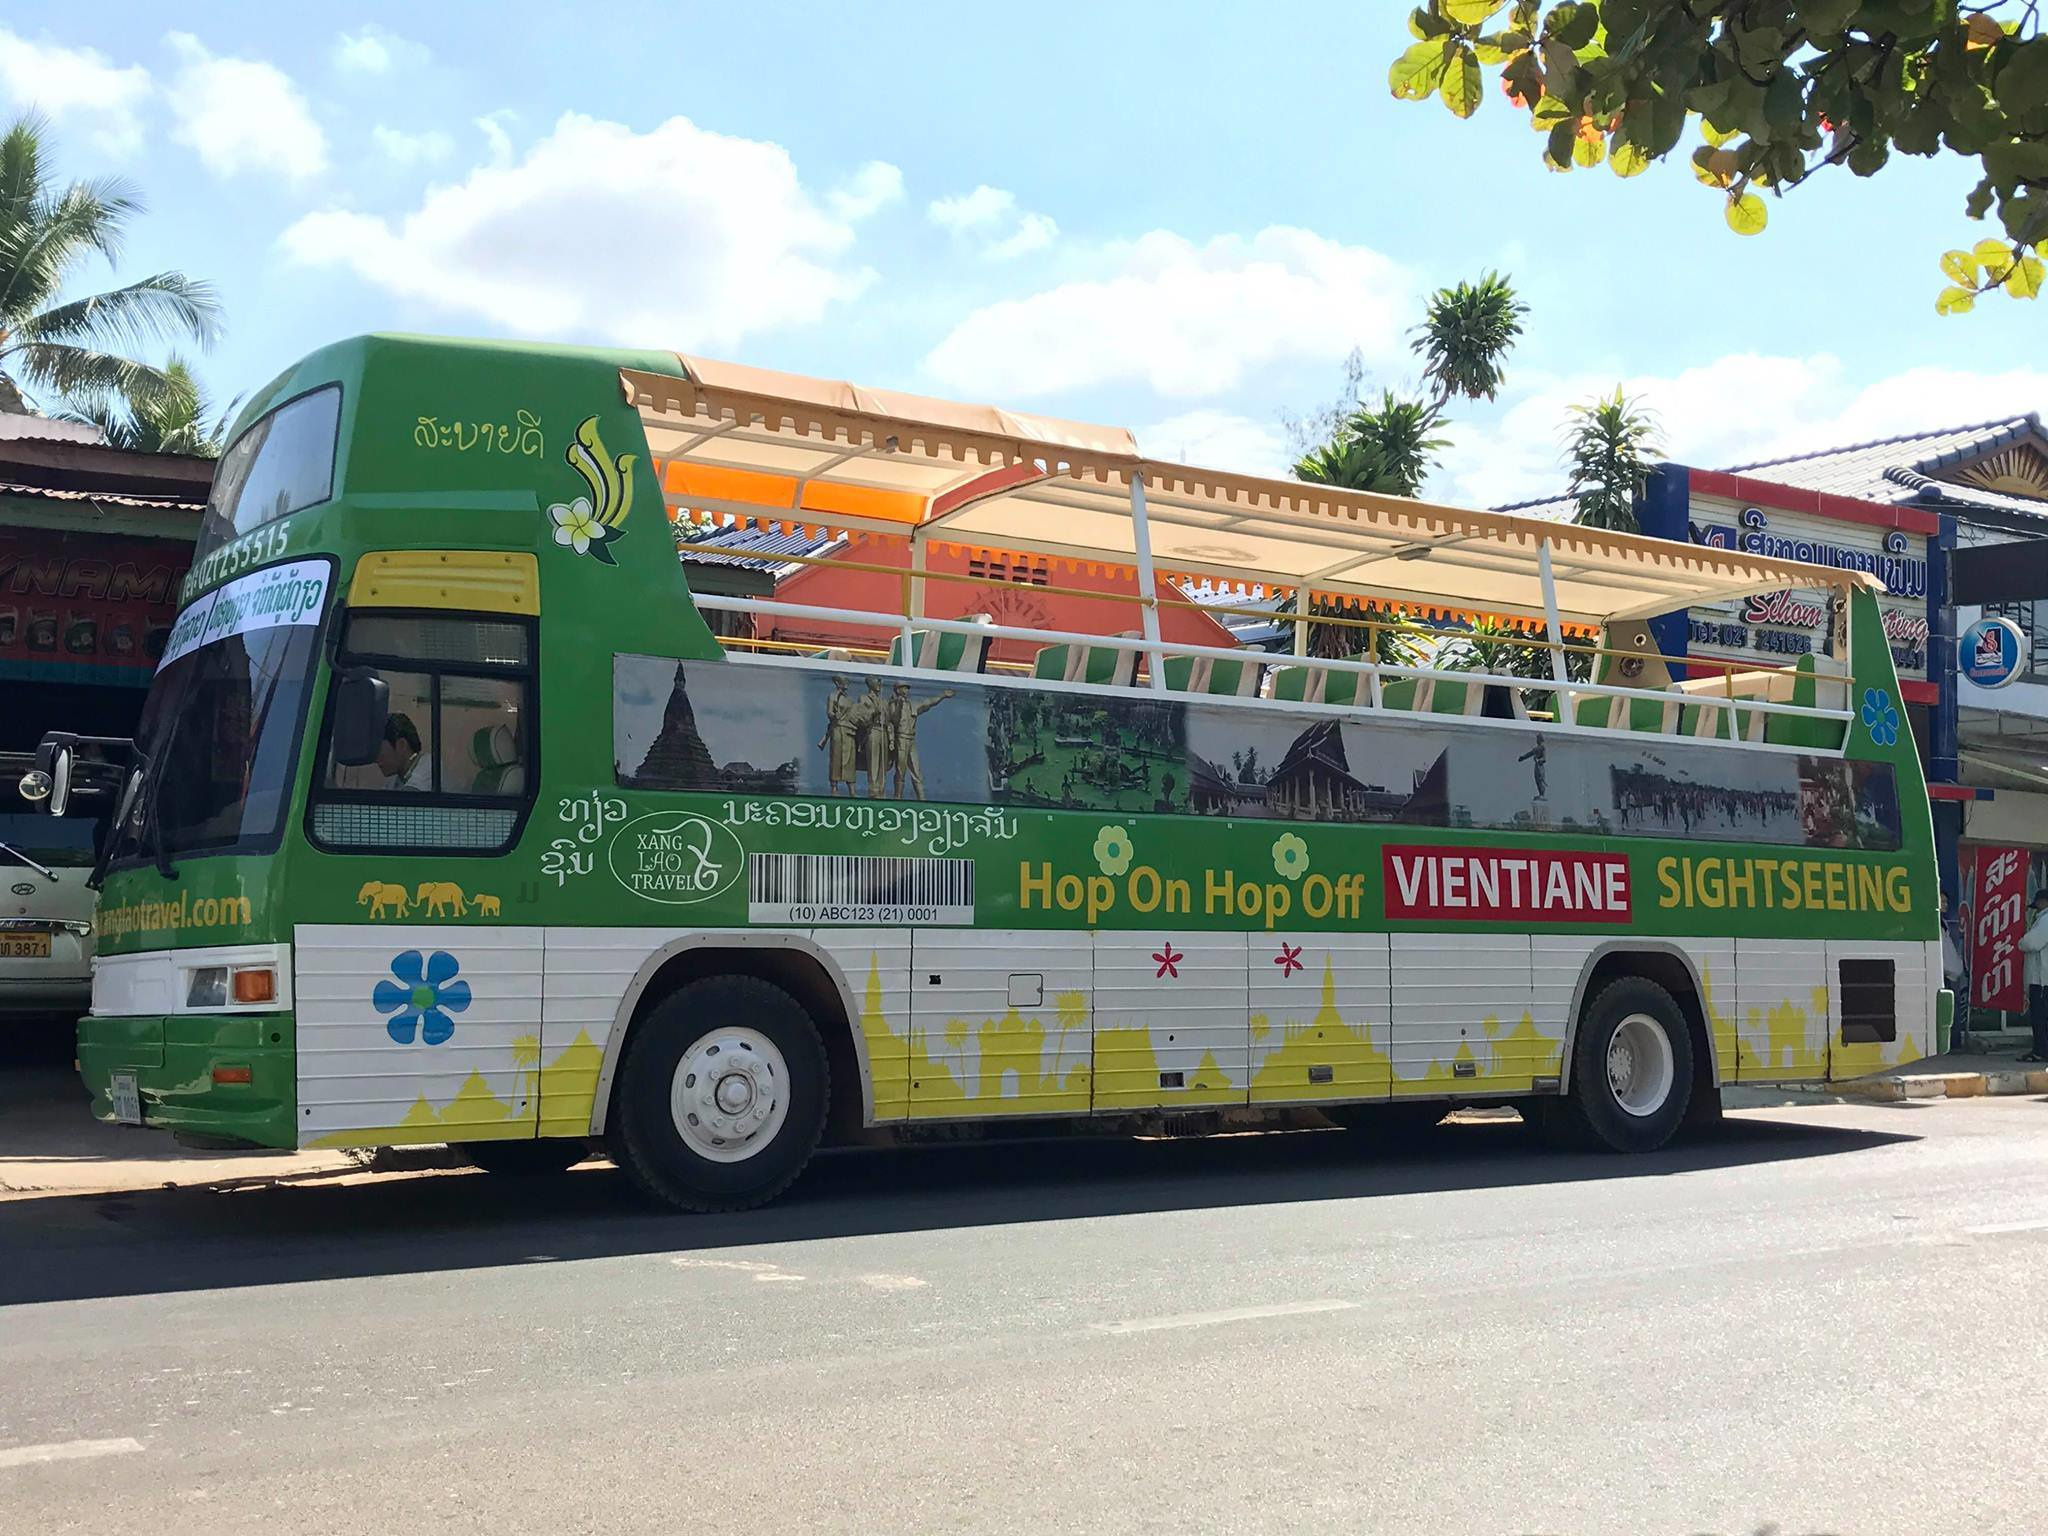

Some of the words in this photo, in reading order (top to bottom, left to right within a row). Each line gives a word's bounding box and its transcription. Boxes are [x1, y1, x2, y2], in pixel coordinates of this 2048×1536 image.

[414, 409, 544, 459] ສະບາຍດີ
[1745, 588, 1823, 628] Sihom
[637, 833, 683, 850] XANG
[638, 851, 682, 872] LAO
[631, 873, 696, 891] TRAVEL
[1019, 861, 1115, 924] Hop
[1128, 866, 1191, 913] On
[1205, 869, 1290, 928] Hop
[1302, 873, 1365, 919] Off
[1391, 855, 1628, 912] VIENTIANE
[1657, 857, 1911, 912] SIGHTSEEING
[789, 906, 816, 922] (10)
[819, 907, 875, 920] ABC123
[878, 907, 904, 922] (21)
[907, 908, 938, 921] 0001
[15, 942, 47, 955] 3871
